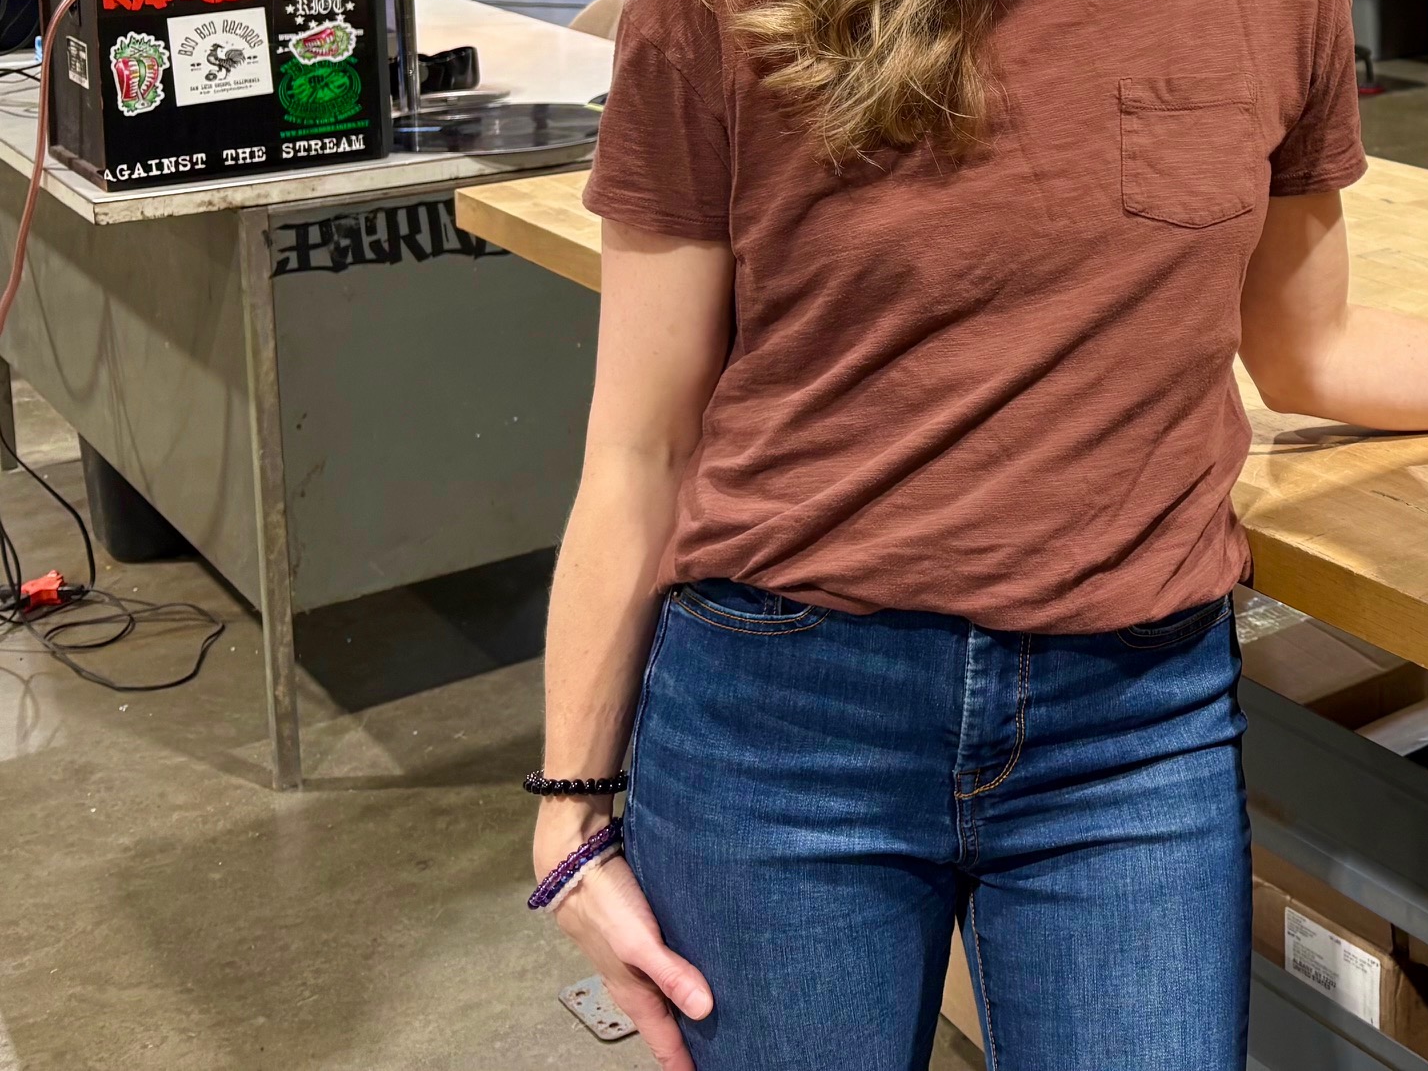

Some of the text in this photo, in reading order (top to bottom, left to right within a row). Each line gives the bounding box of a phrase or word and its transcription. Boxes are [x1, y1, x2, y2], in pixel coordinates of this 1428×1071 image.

[177, 36, 199, 57] BOO
[194, 20, 217, 40] BOO
[222, 19, 264, 49] RECORDS
[103, 134, 366, 183] AGAINST THE STREAM
